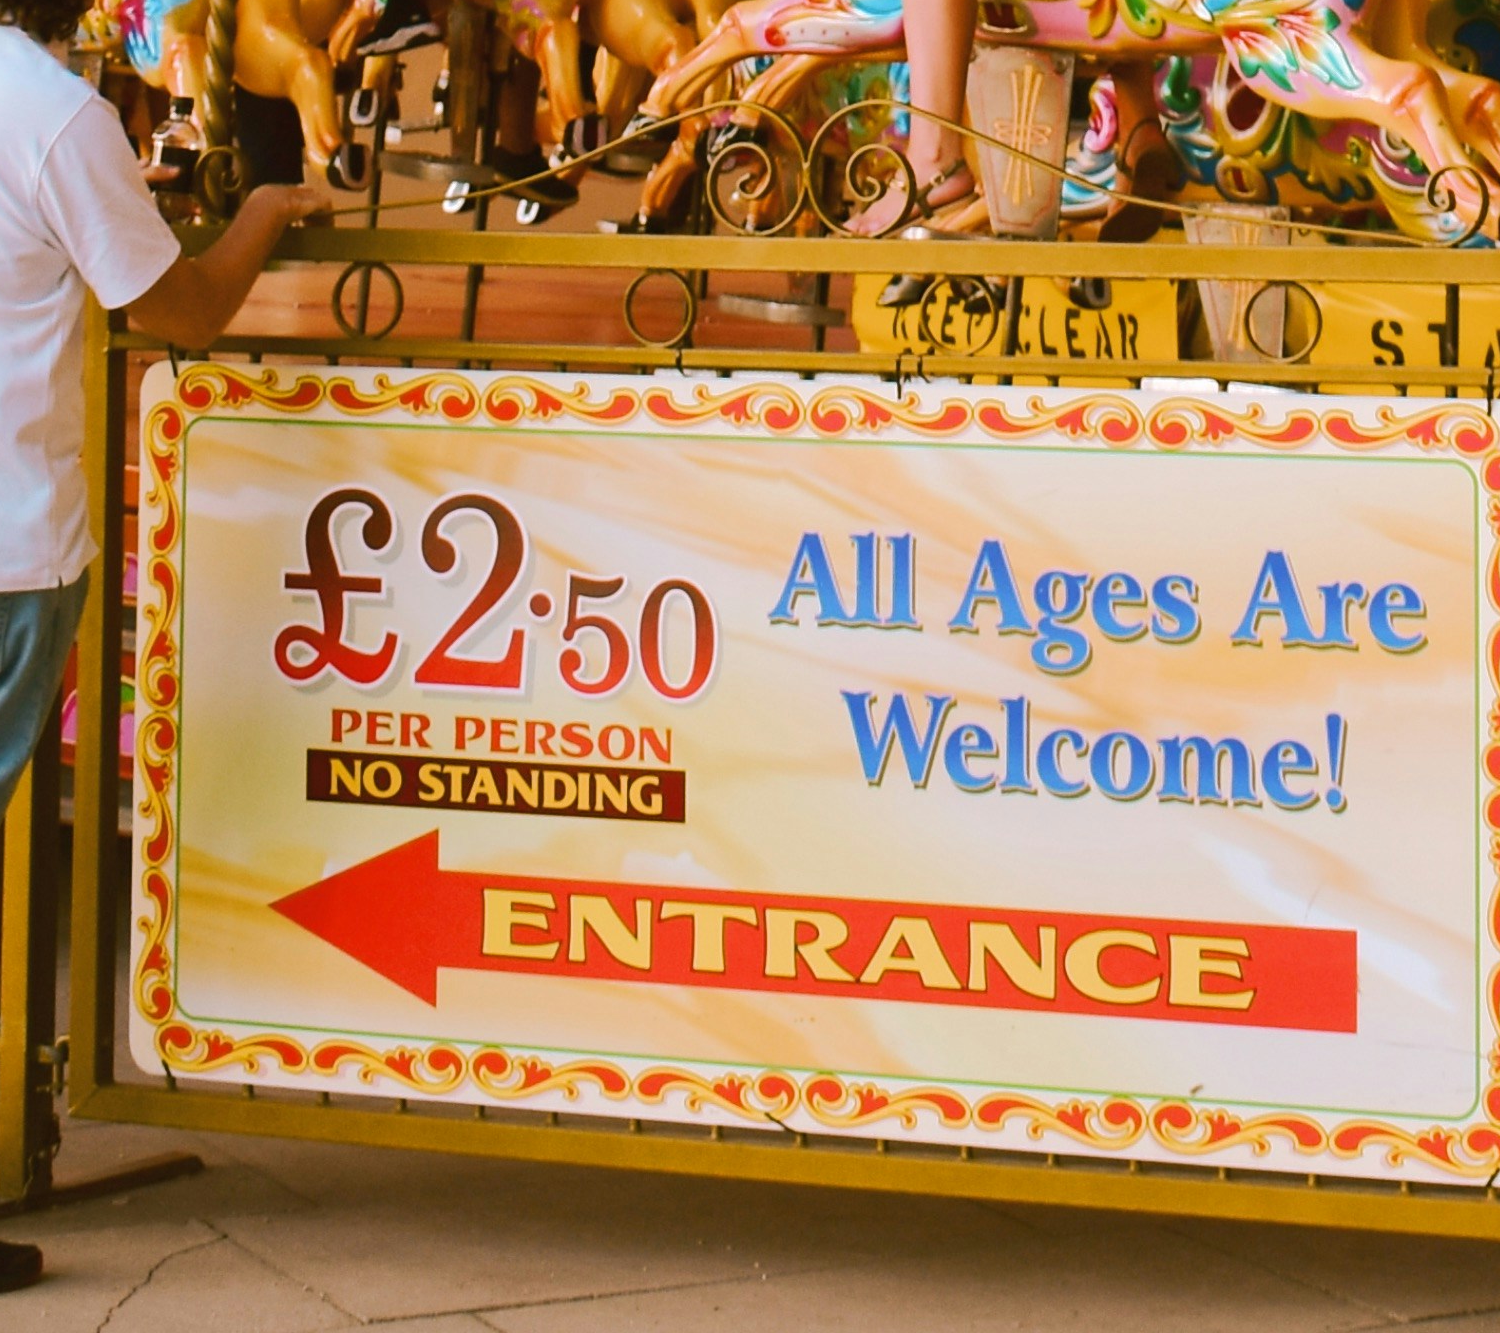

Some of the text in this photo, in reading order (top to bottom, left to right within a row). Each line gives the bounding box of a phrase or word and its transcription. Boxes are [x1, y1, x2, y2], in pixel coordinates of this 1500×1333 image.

[768, 530, 1428, 674] All Ages Are
[328, 758, 663, 816] NO STANDING
[331, 708, 672, 765] PER PERSON
[839, 689, 1348, 814] Welcome!
[481, 887, 1257, 1013] ENTRANCE
